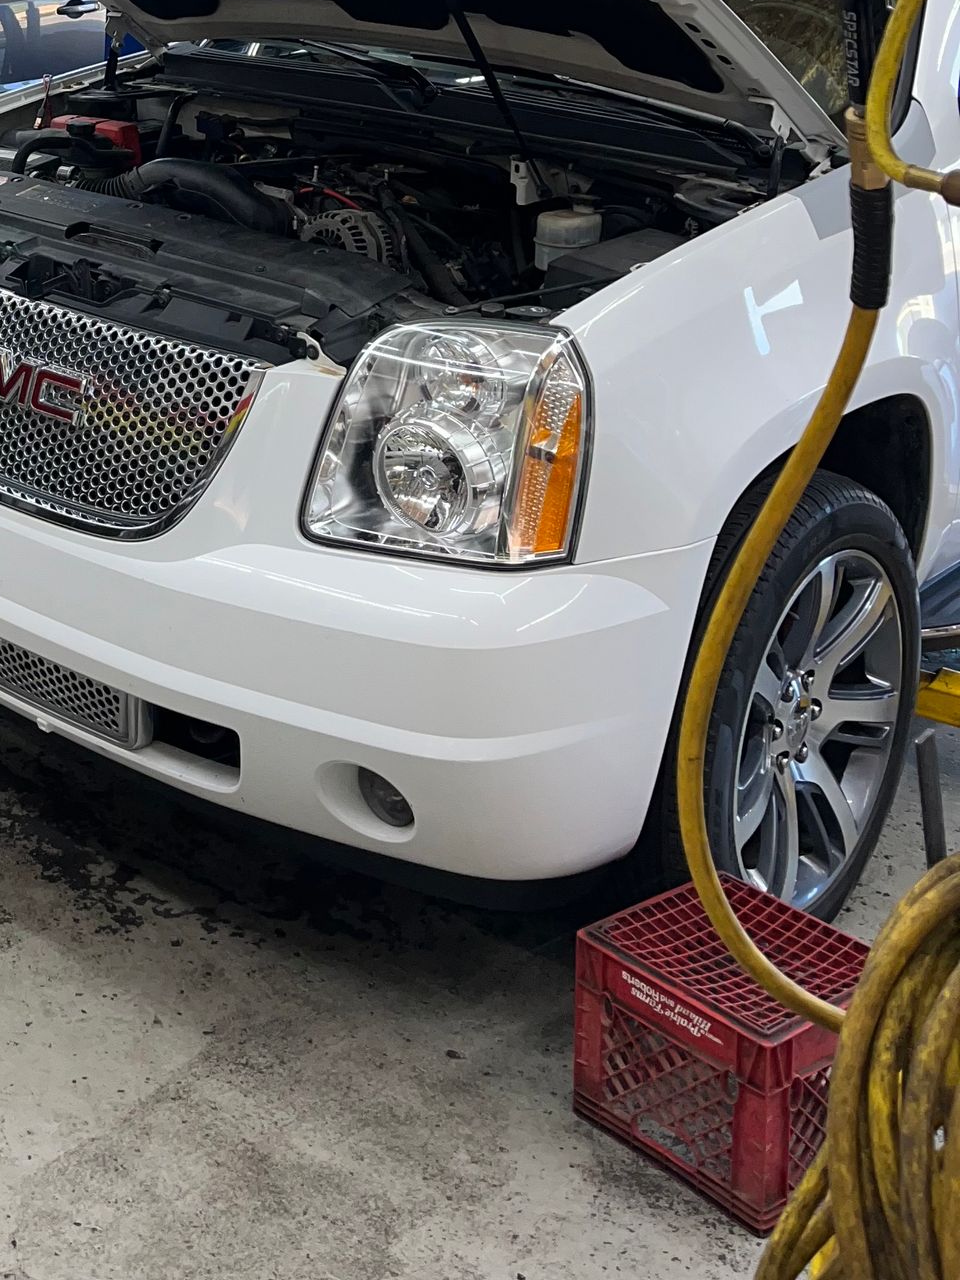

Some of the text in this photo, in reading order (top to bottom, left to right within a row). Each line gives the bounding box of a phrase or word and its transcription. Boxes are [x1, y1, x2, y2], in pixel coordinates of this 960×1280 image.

[621, 970, 712, 1032] Hiland and Roberts
[630, 986, 707, 1038] Prairie Farms
